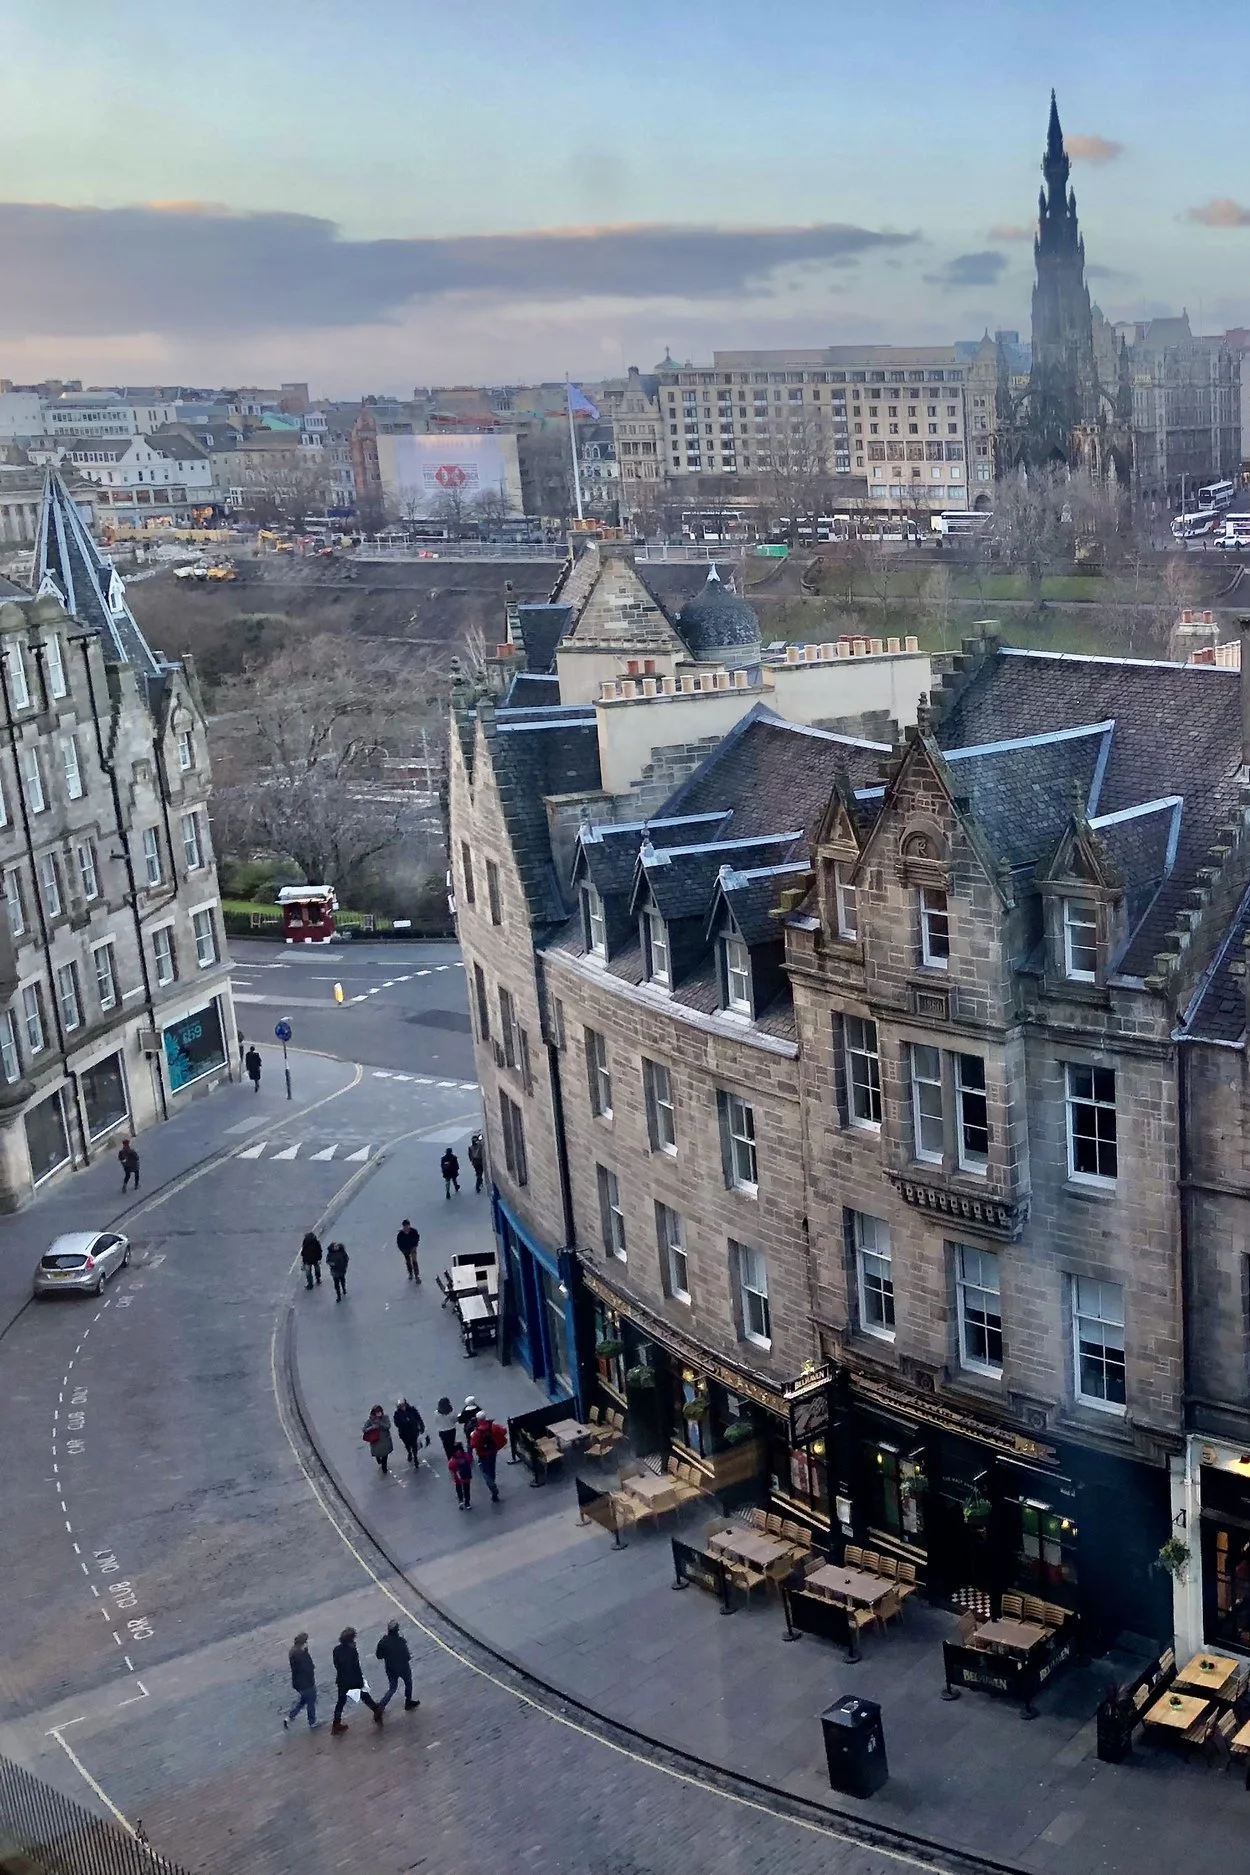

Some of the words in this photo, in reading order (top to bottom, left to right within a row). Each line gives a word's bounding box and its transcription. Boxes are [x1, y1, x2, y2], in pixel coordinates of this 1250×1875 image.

[182, 1025, 202, 1044] £59
[71, 1386, 88, 1404] ONLY
[67, 1411, 86, 1431] CLUB
[66, 1438, 85, 1454] CAR
[93, 1549, 120, 1573] ONLY
[109, 1581, 138, 1608] CLUB
[127, 1616, 155, 1640] CAR
